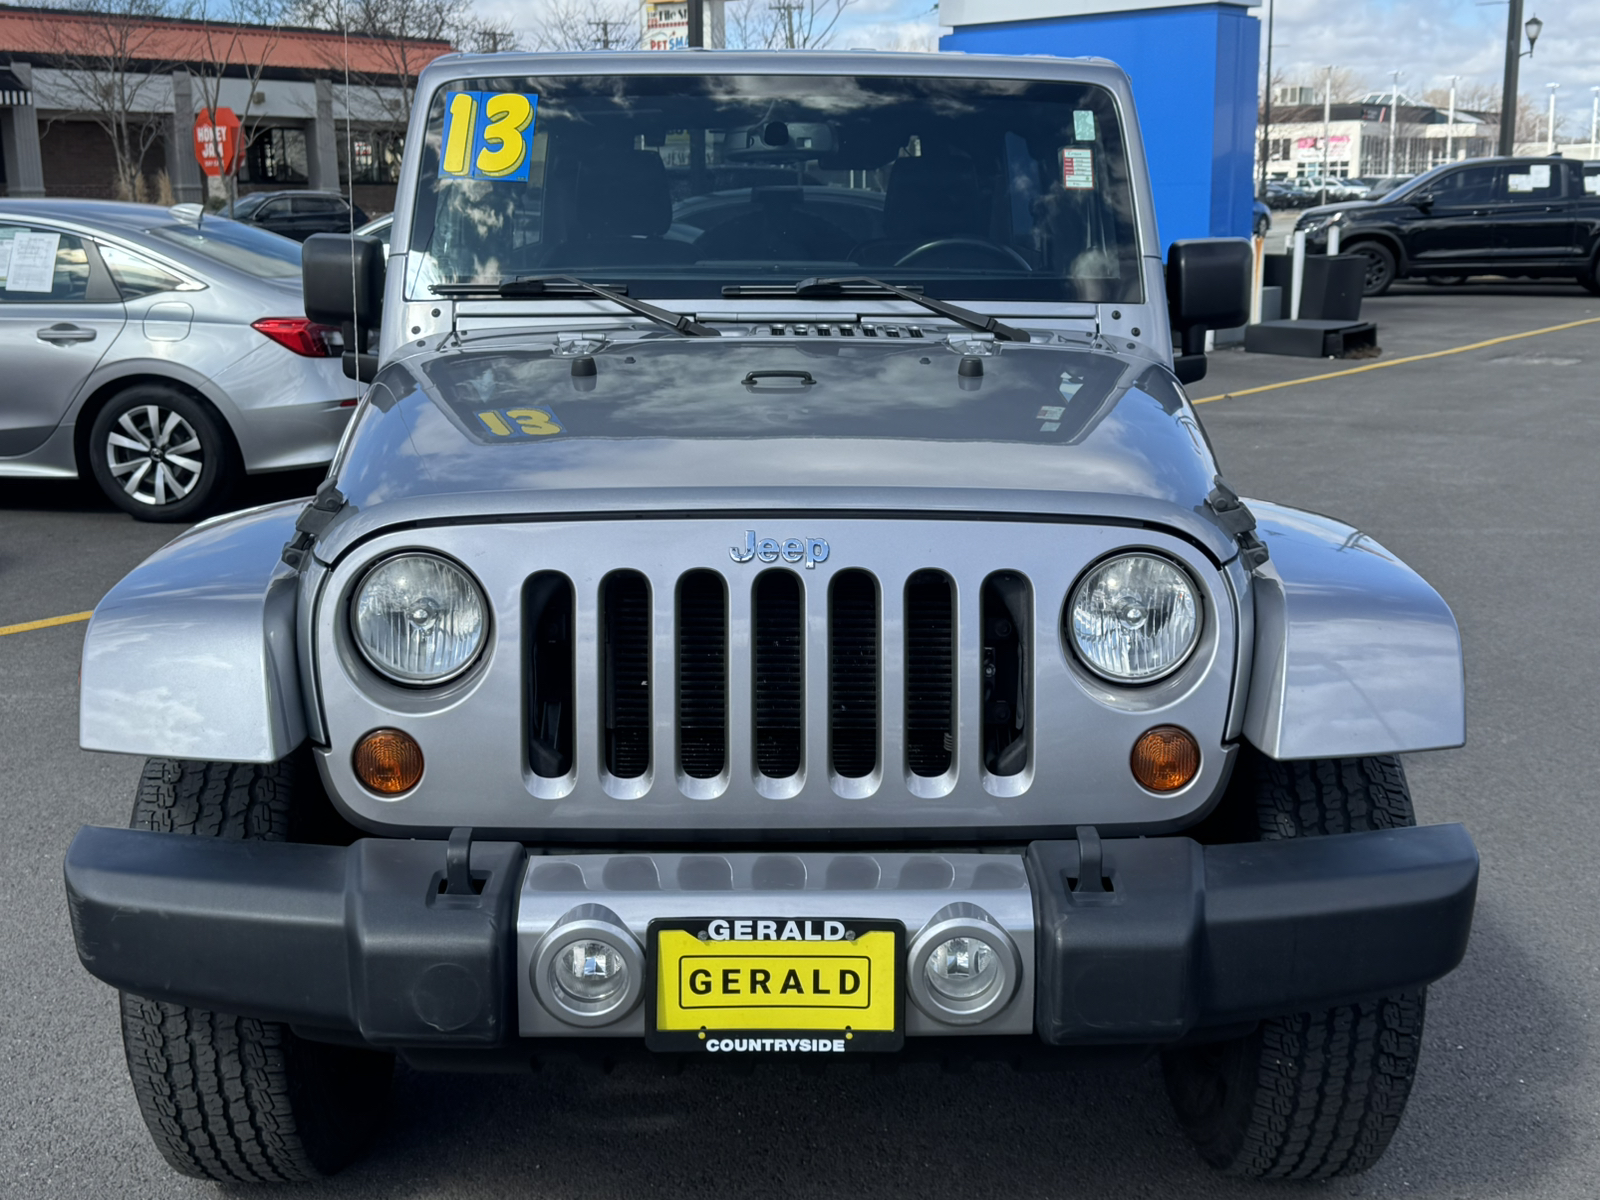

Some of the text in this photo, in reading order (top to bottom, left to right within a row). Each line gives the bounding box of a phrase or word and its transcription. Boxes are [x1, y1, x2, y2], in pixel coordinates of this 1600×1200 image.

[443, 93, 534, 176] 13
[729, 530, 830, 569] Jeep
[707, 919, 846, 941] GERALD
[689, 968, 861, 995] GERALD
[706, 1038, 845, 1052] COUNTRYSIDE
